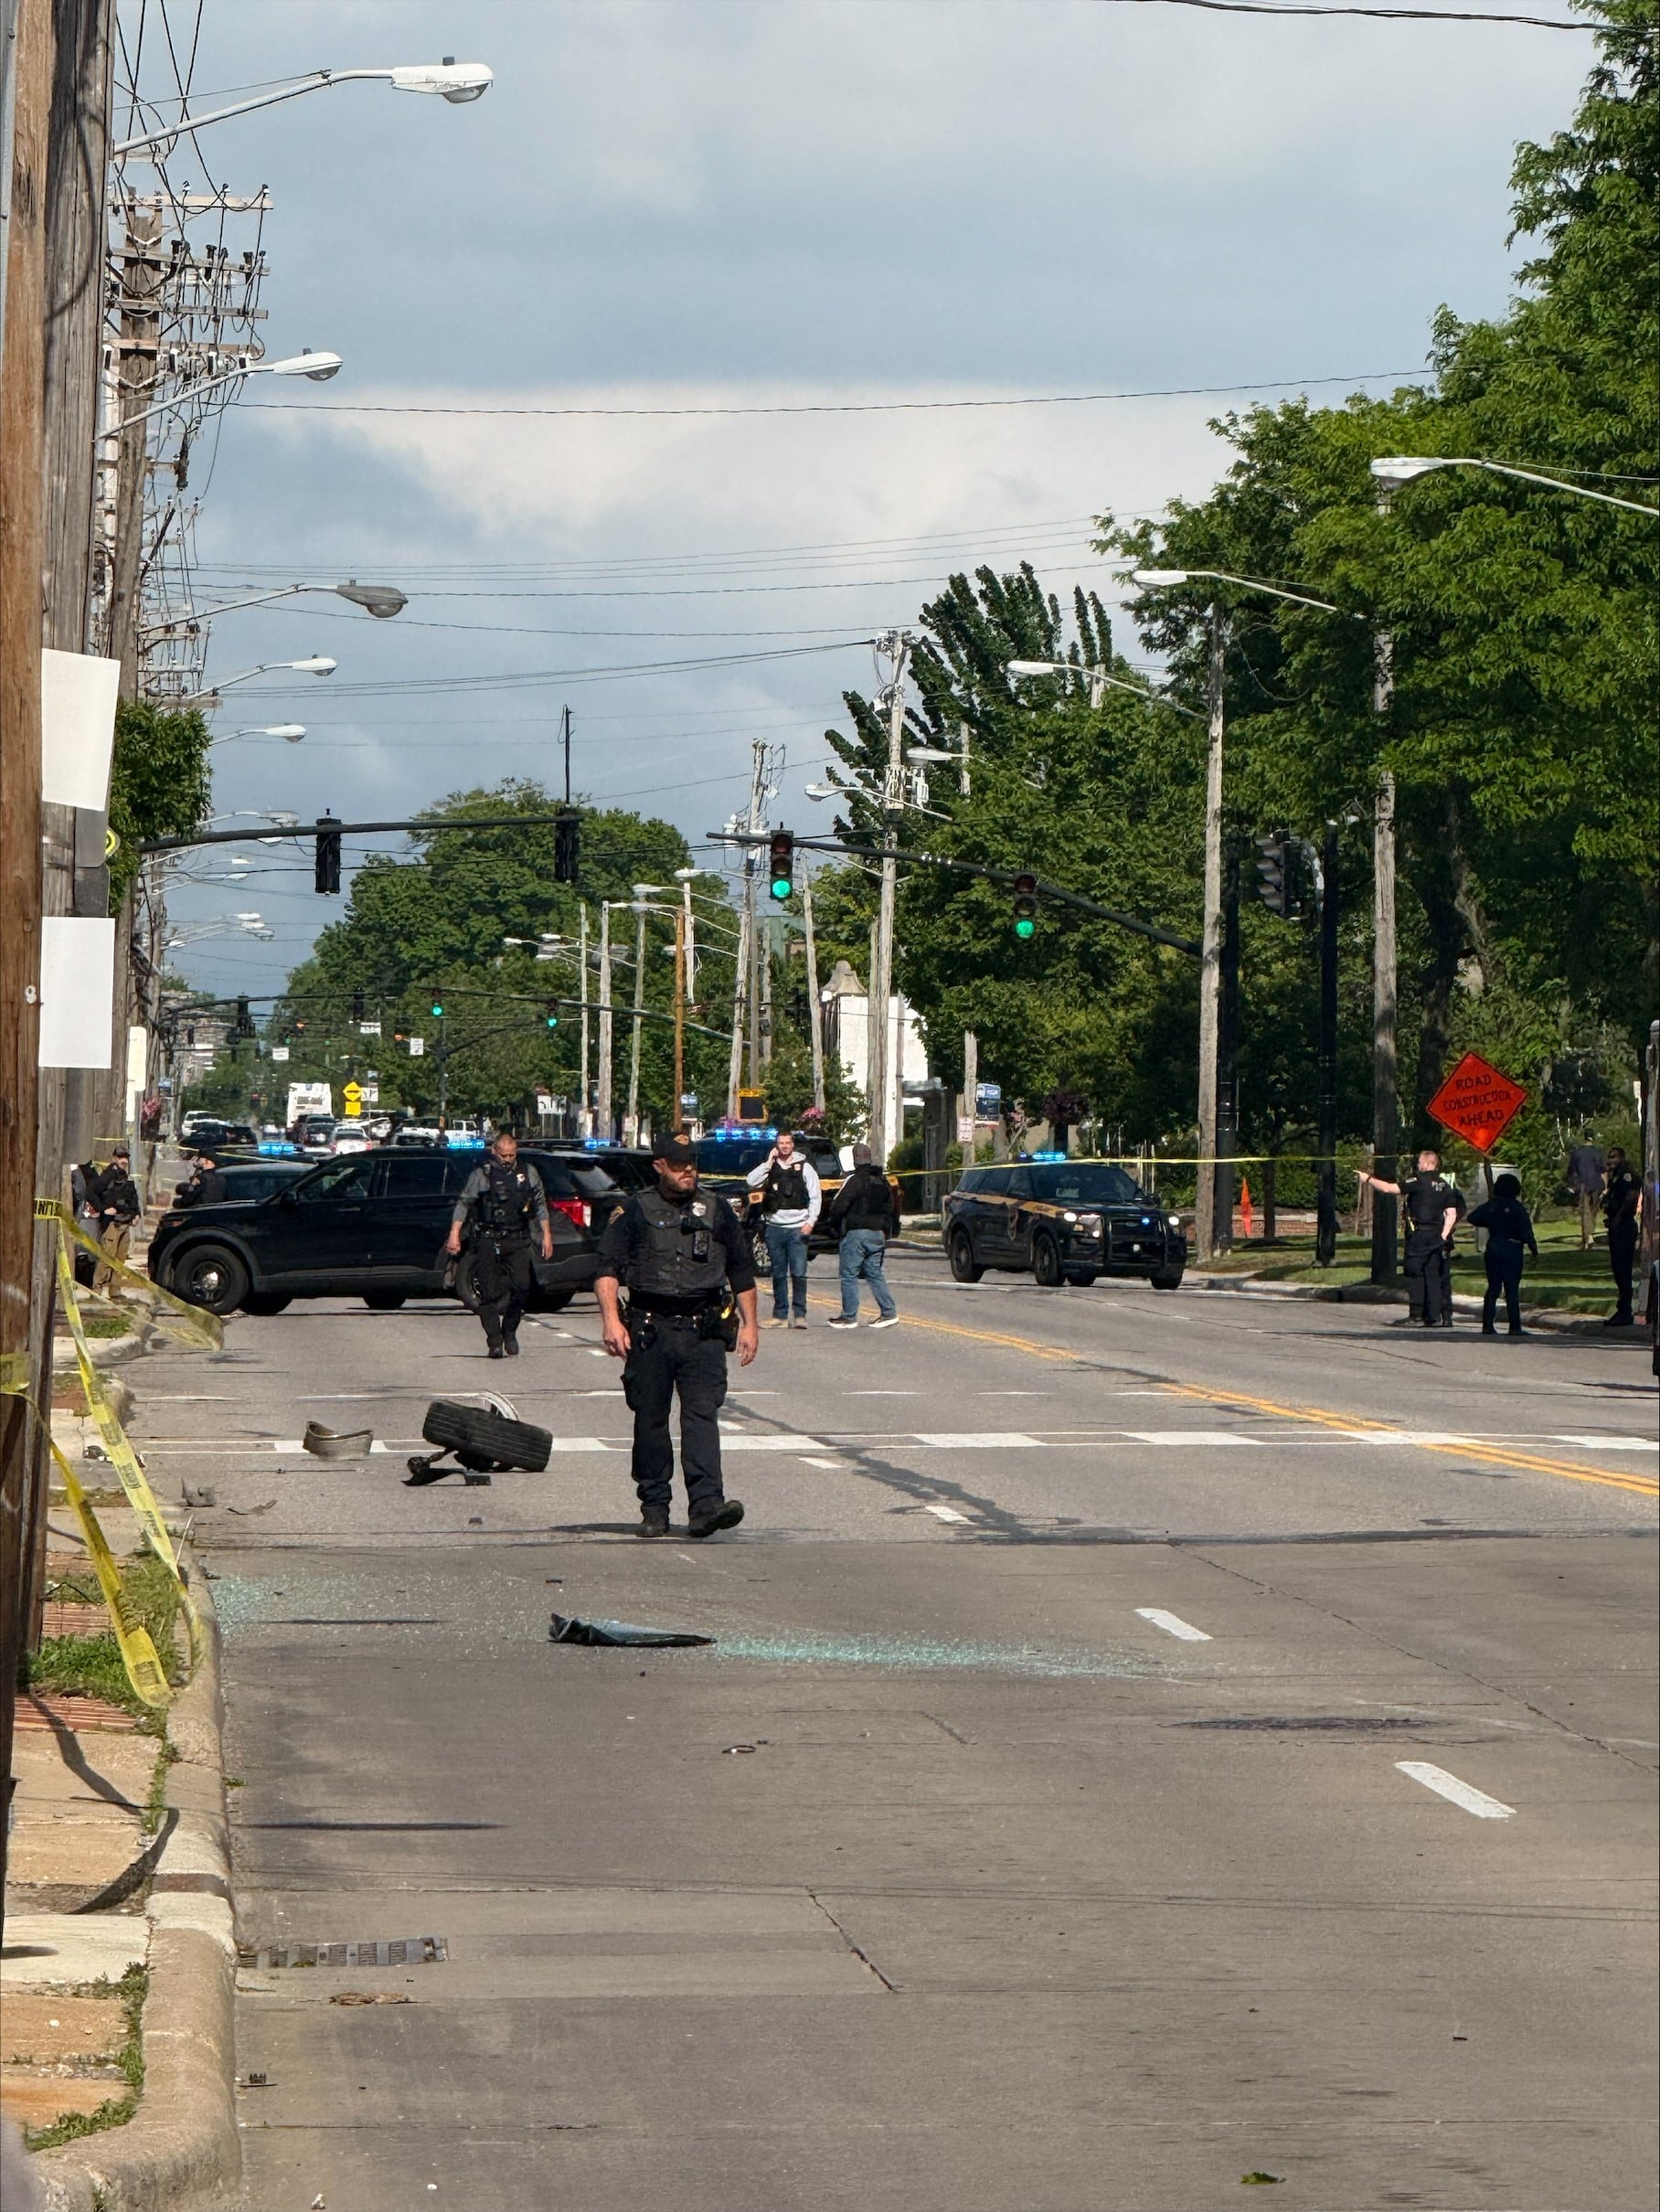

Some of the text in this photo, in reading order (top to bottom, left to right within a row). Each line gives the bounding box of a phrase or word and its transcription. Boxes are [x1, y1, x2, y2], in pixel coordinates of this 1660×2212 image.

[1455, 1074, 1492, 1090] ROAD
[1443, 1090, 1511, 1111] CONSTRUCTION
[1459, 1109, 1504, 1126] AHEAD
